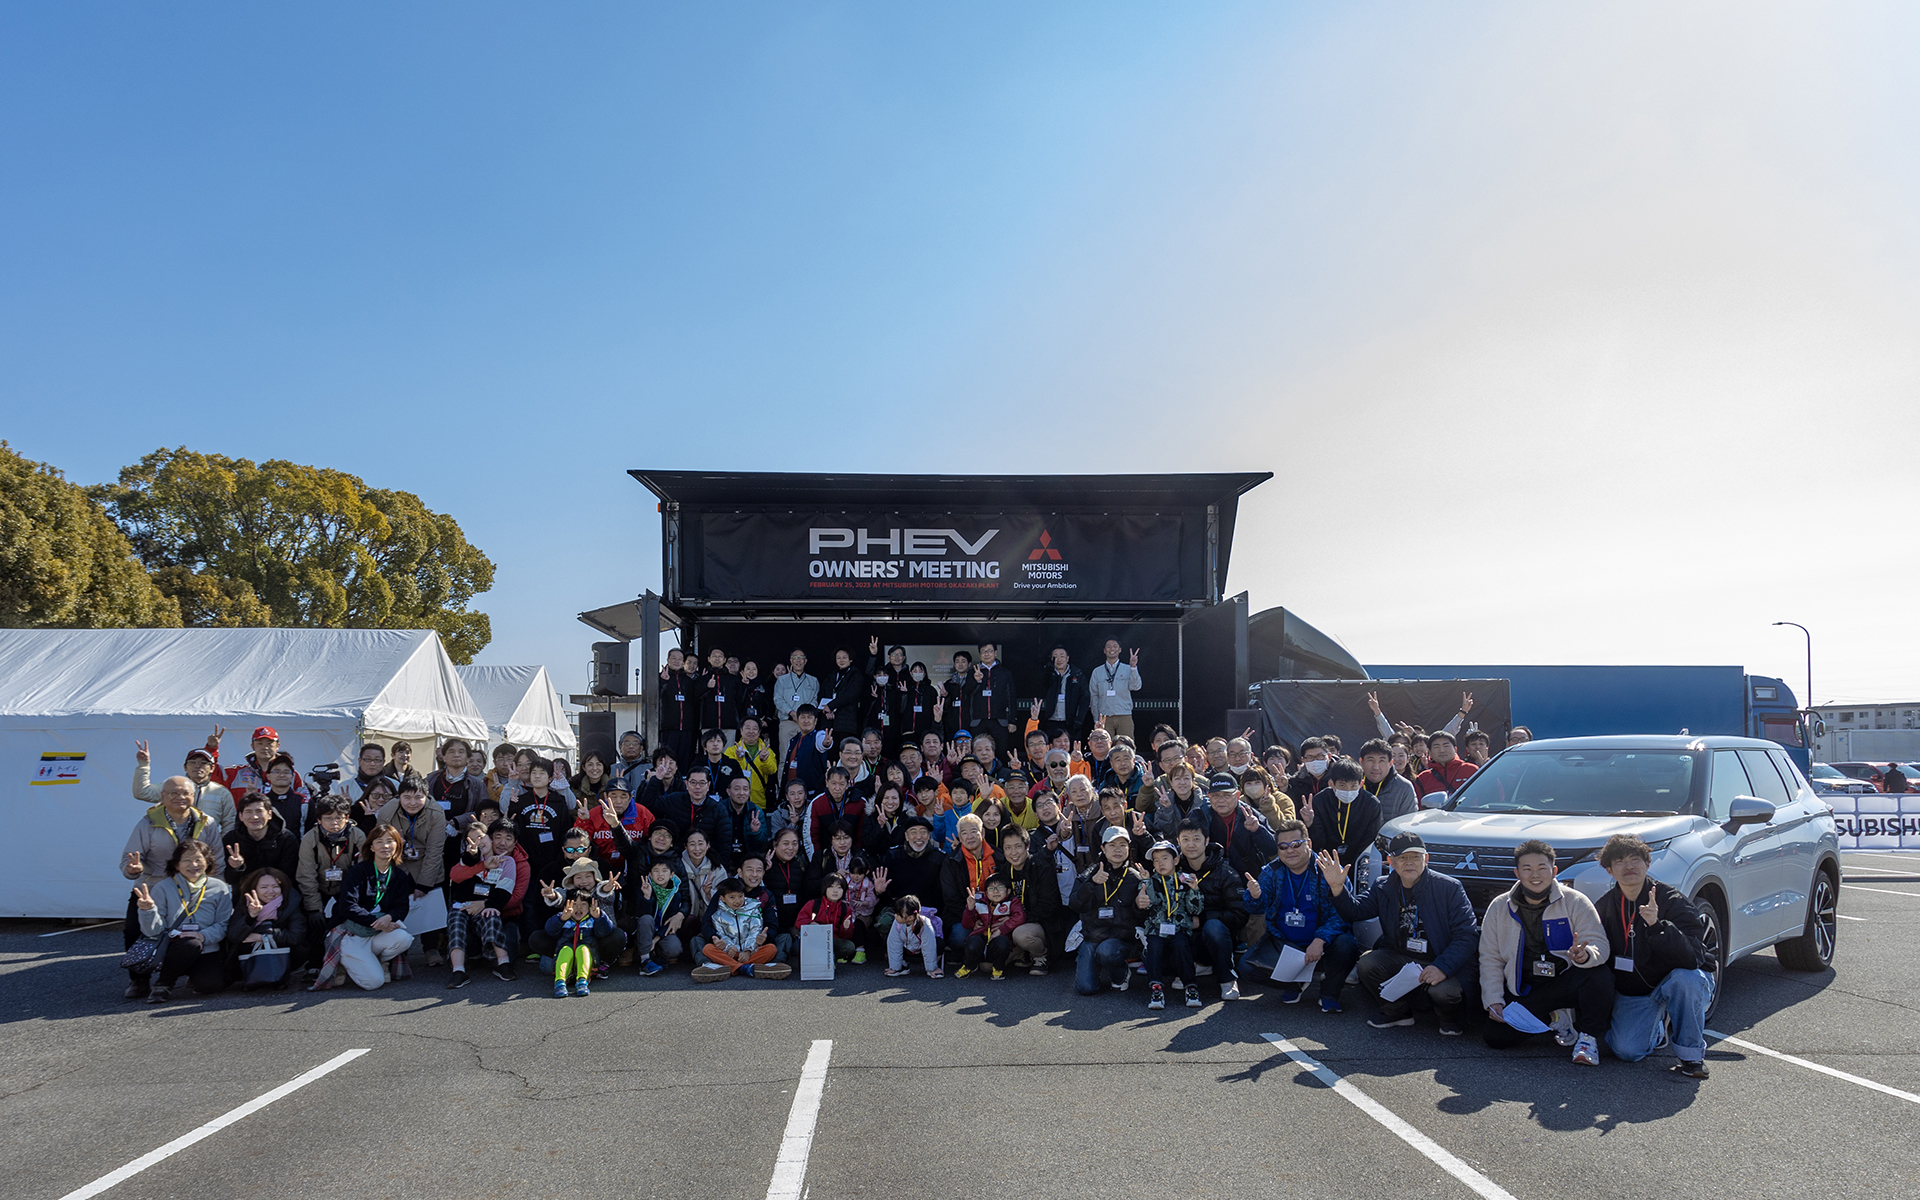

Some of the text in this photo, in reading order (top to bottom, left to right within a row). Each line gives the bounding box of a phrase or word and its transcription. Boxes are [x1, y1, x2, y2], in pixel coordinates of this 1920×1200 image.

[809, 528, 1000, 555] PHEV
[809, 560, 1000, 579] OWNERS' MEETING
[1021, 563, 1069, 571] MITSUBISHI
[1028, 571, 1063, 579] MOTORS
